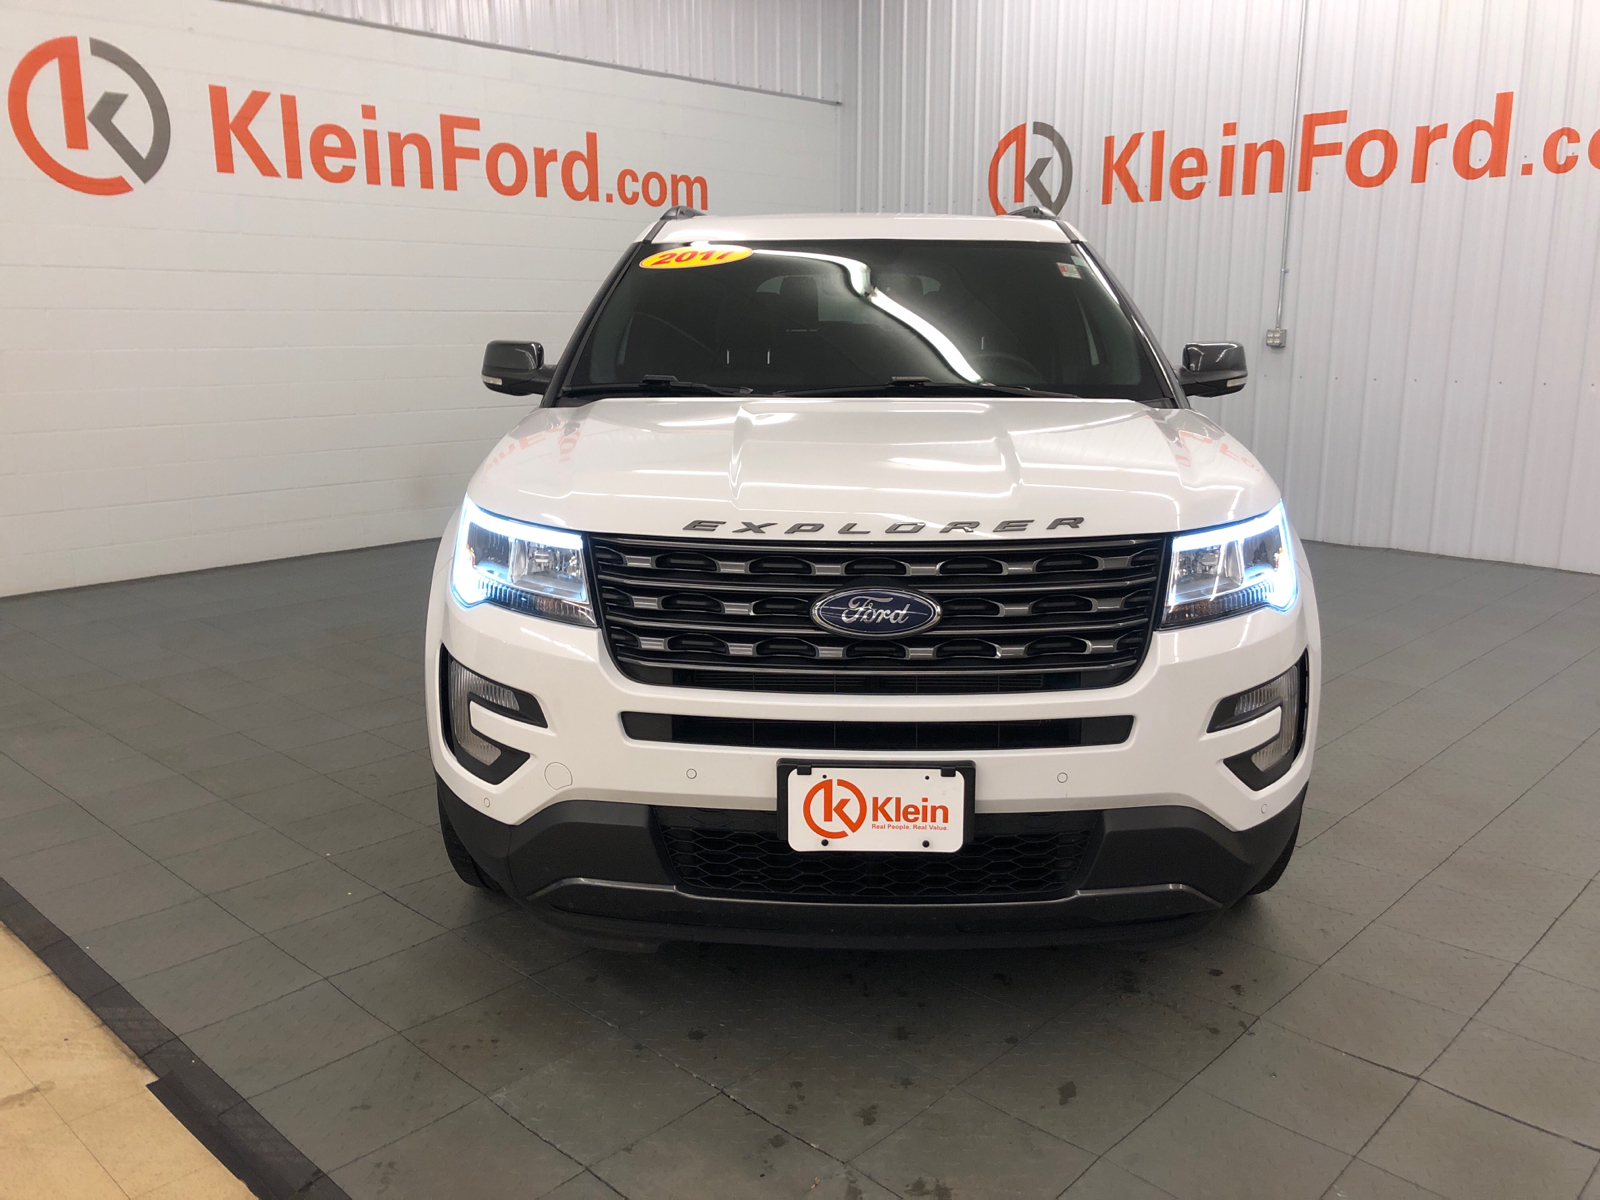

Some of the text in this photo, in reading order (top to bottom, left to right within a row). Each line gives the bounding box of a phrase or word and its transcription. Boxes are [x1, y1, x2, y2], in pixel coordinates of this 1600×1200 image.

[209, 84, 709, 210] KleinFord.com
[682, 516, 1085, 534] EXPLORER
[842, 595, 910, 626] Ford
[872, 796, 949, 823] Klein
